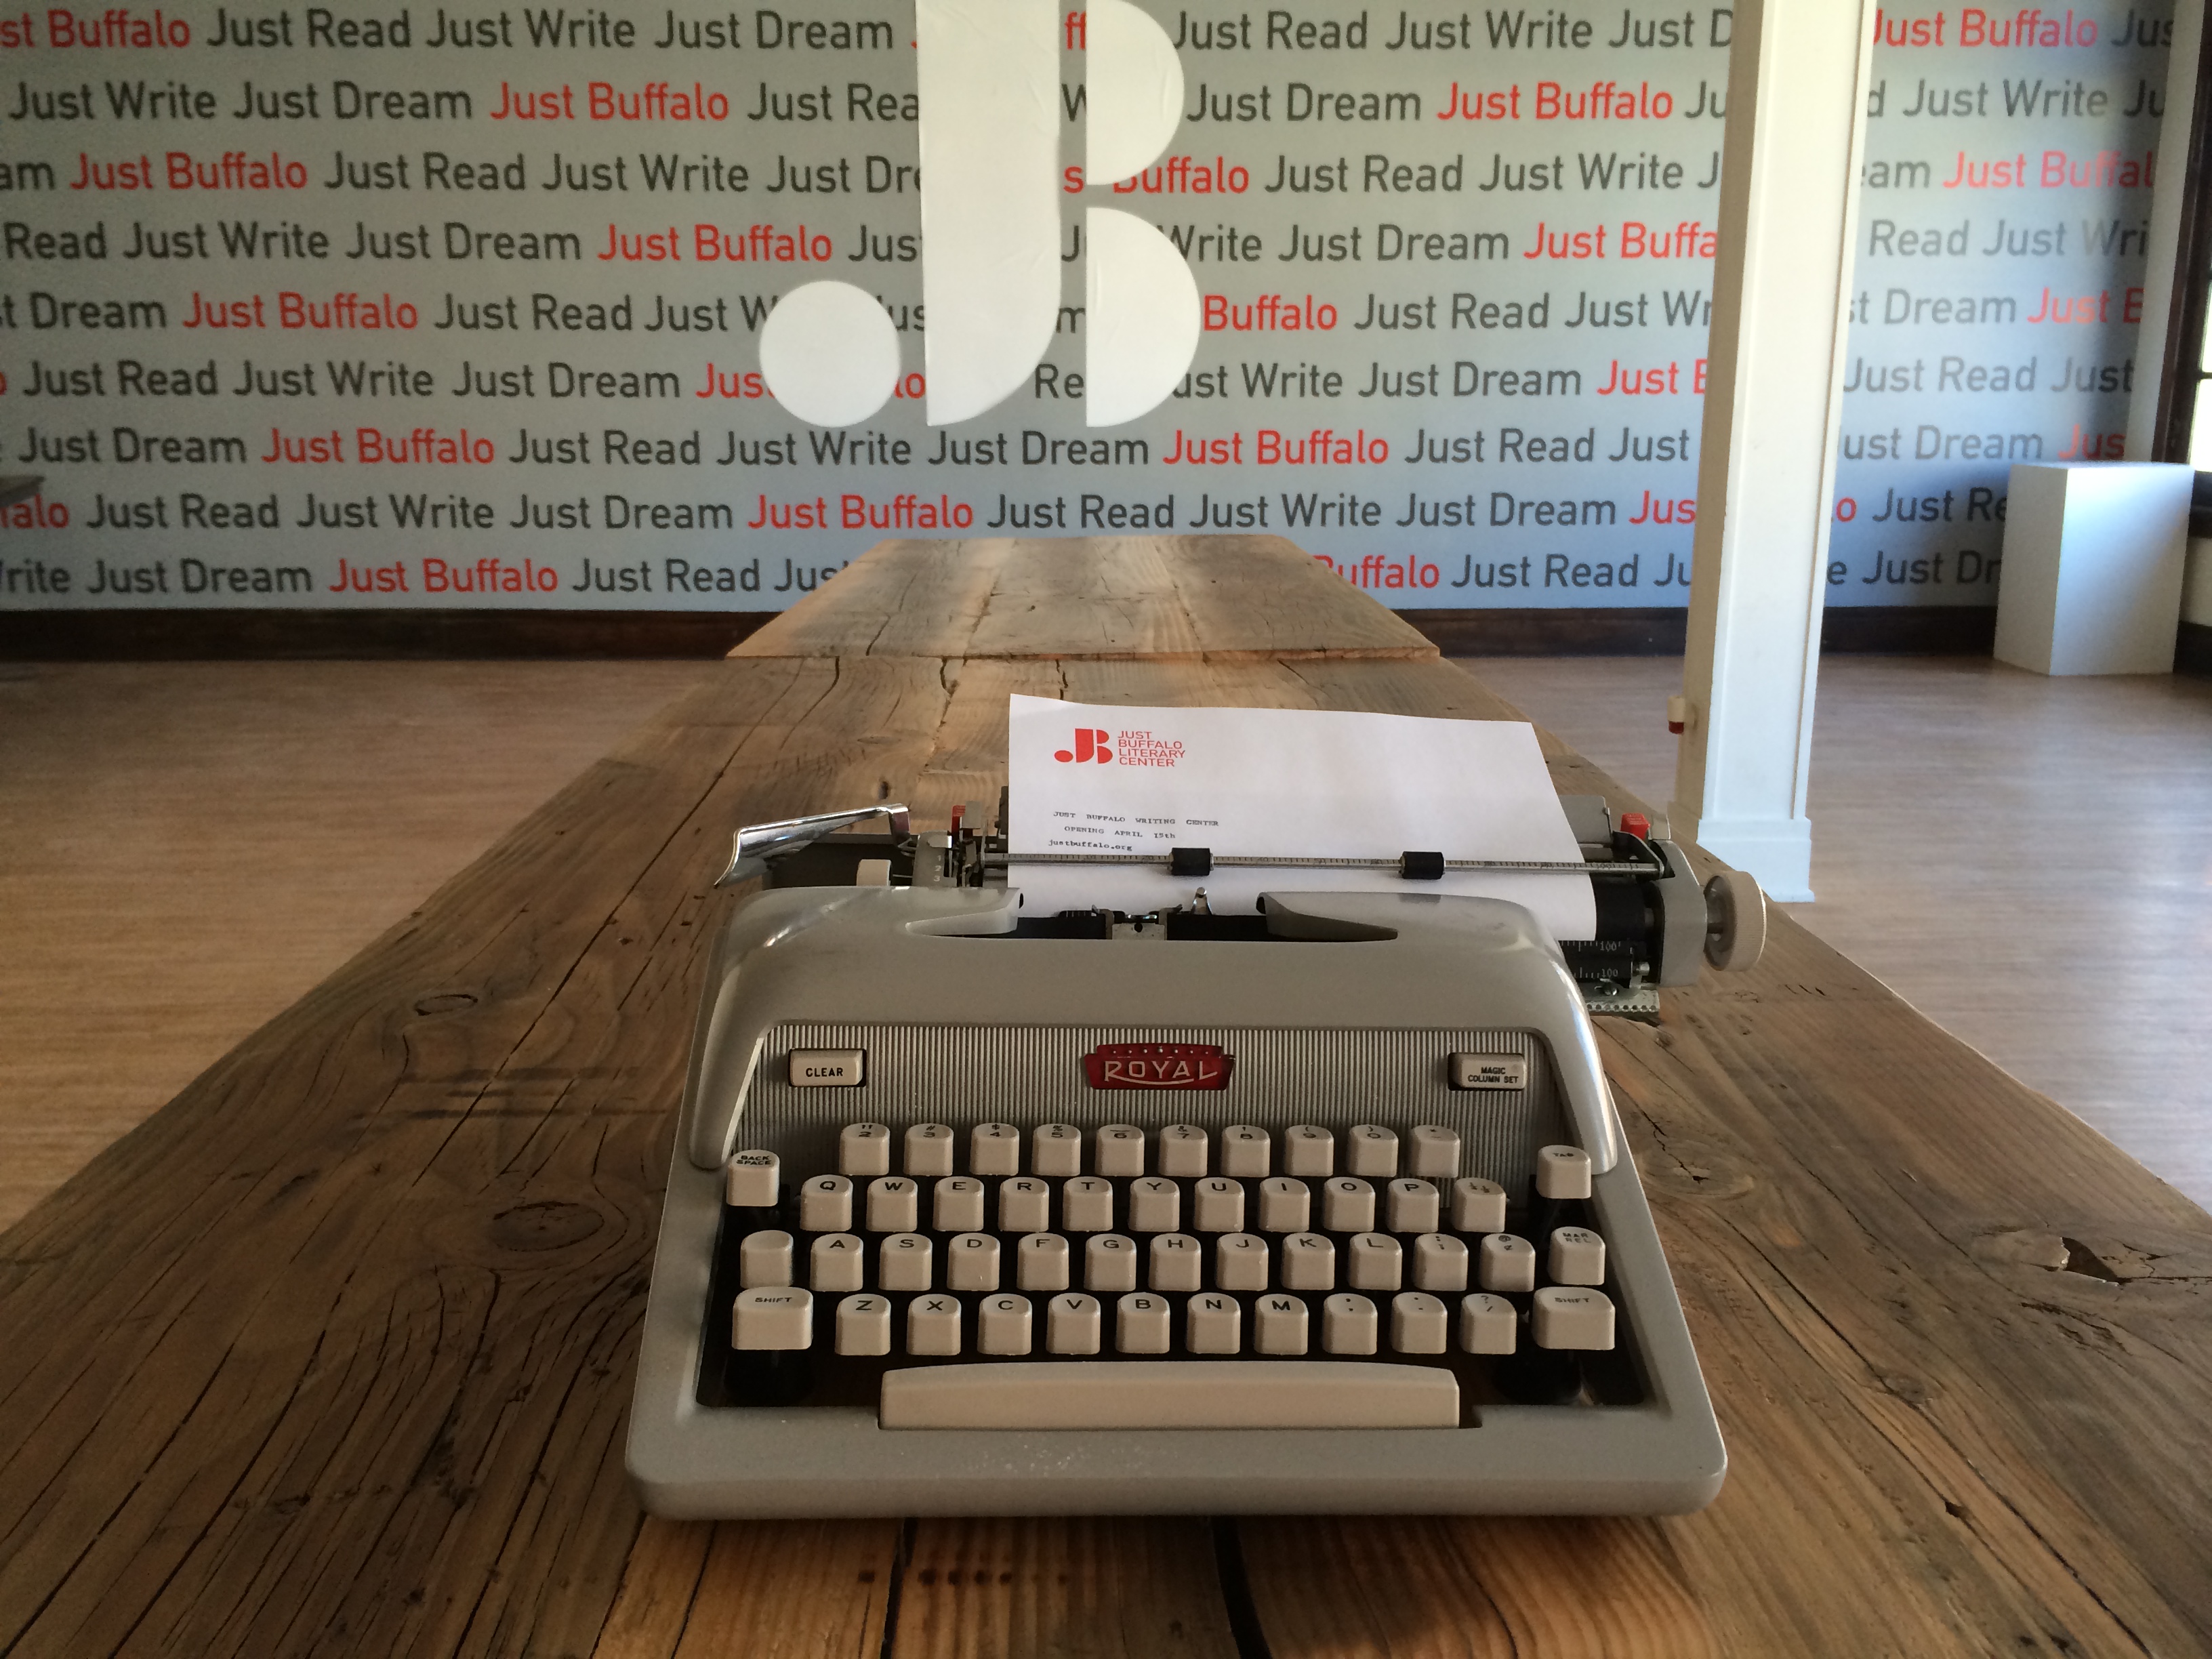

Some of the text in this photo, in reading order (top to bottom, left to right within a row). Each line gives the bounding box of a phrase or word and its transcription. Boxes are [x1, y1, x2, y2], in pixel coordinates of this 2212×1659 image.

[47, 8, 191, 48] Buffalo
[206, 7, 293, 48] Just
[306, 7, 411, 48] Read
[426, 8, 513, 48] Just
[523, 8, 636, 48] Write
[654, 9, 741, 49] Just
[756, 9, 893, 50] Dream
[1267, 10, 1368, 50] Read
[1385, 11, 1471, 50] Just
[1486, 9, 1593, 49] Write
[1608, 9, 1694, 48] Just
[1959, 7, 2097, 47] Buffalo
[7, 81, 96, 121] Just
[104, 80, 217, 120] Write
[232, 81, 320, 120] Just
[333, 80, 472, 120] Dream
[490, 81, 575, 120] Just
[588, 81, 729, 121] Buffalo
[747, 82, 833, 121] Just
[1186, 83, 1271, 122] Just
[1287, 82, 1421, 121] Dream
[1437, 81, 1521, 121] Just
[1536, 81, 1673, 120] Buffalo
[1902, 79, 1988, 117] Just
[2003, 79, 2108, 118] Write
[69, 152, 154, 190] Just
[165, 151, 308, 190] Buffalo
[324, 150, 410, 190] Just
[423, 151, 526, 191] Read
[541, 152, 628, 192] Just
[639, 153, 749, 192] Write
[766, 155, 851, 194] Just
[1265, 155, 1348, 193] Just
[1364, 154, 1463, 192] Read
[1479, 154, 1563, 192] Just
[1578, 152, 1683, 190] Write
[1942, 151, 2026, 188] Just
[3, 220, 1969, 262] Read Just Write Just Dream Just Buffalo Just Dream Just Read
[28, 291, 167, 330] Dream
[182, 291, 266, 329] Just
[279, 291, 418, 329] Buffalo
[434, 293, 518, 330] Just
[531, 293, 632, 331] Read
[644, 295, 729, 332] Just
[1204, 294, 1337, 331] Buffalo
[1354, 293, 1437, 330] Just
[1452, 292, 1549, 329] Read
[1564, 291, 1648, 328] Just
[22, 360, 106, 397] Just
[117, 359, 218, 396] Read
[232, 359, 317, 396] Just
[326, 361, 434, 397] Write
[451, 361, 535, 398] Just
[548, 361, 680, 398] Dream
[1241, 363, 1343, 398] Write
[1358, 362, 1439, 398] Just
[1453, 361, 1581, 396] Dream
[1597, 360, 1679, 395] Just
[18, 426, 101, 464] Just
[112, 426, 247, 464] Dream
[261, 427, 344, 464] Just
[356, 428, 495, 464] Buffalo
[508, 428, 591, 464] Just
[604, 429, 701, 466] Read
[716, 430, 797, 466] Just
[808, 430, 912, 466] Write
[927, 430, 1008, 466] Just
[1022, 430, 1149, 466] Dream
[1162, 429, 1242, 465] Just
[1257, 429, 1389, 465] Buffalo
[1404, 428, 1485, 464] Just
[1499, 428, 1595, 463] Read
[1608, 427, 1689, 462] Just
[1915, 425, 2043, 460] Dream
[85, 493, 169, 529] Just
[180, 493, 280, 529] Read
[296, 493, 379, 529] Just
[388, 493, 494, 529] Write
[510, 493, 591, 529] Just
[604, 494, 733, 529] Dream
[747, 494, 827, 529] Just
[841, 494, 973, 529] Buffalo
[987, 493, 1066, 529] Just
[1080, 494, 1174, 529] Read
[1189, 493, 1269, 529] Just
[1281, 493, 1382, 527] Write
[1396, 493, 1475, 527] Just
[1490, 492, 1616, 527] Dream
[86, 558, 169, 595] Just
[180, 557, 313, 594] Dream
[329, 558, 410, 593] Just
[422, 558, 558, 593] Buffalo
[571, 558, 652, 592] Just
[665, 558, 760, 592] Read
[1451, 554, 1531, 588] Just
[1544, 553, 1639, 588] Read
[1861, 550, 1945, 586] Just
[1118, 731, 1152, 739] JUST
[1118, 739, 1183, 749] BUFFALO
[1119, 748, 1185, 758] LITERARY
[1120, 757, 1175, 767] CENTER
[1086, 814, 1126, 822] BUFFALO
[1064, 825, 1105, 834] OPENING
[1048, 839, 1132, 852] justbuffalo.org
[805, 1067, 843, 1077] CLEAR
[1104, 1061, 1218, 1084] ROYAL
[819, 1181, 836, 1191] Q
[884, 1181, 903, 1191] W
[952, 1181, 966, 1190] E
[1017, 1182, 1032, 1191] R
[1080, 1181, 1095, 1190] T
[1146, 1182, 1162, 1191] Y
[1211, 1182, 1227, 1191] U
[1404, 1183, 1420, 1191] P
[829, 1239, 846, 1248] A
[899, 1239, 915, 1248] S
[966, 1239, 983, 1248] D
[1036, 1238, 1050, 1248] F
[1103, 1240, 1120, 1248] G
